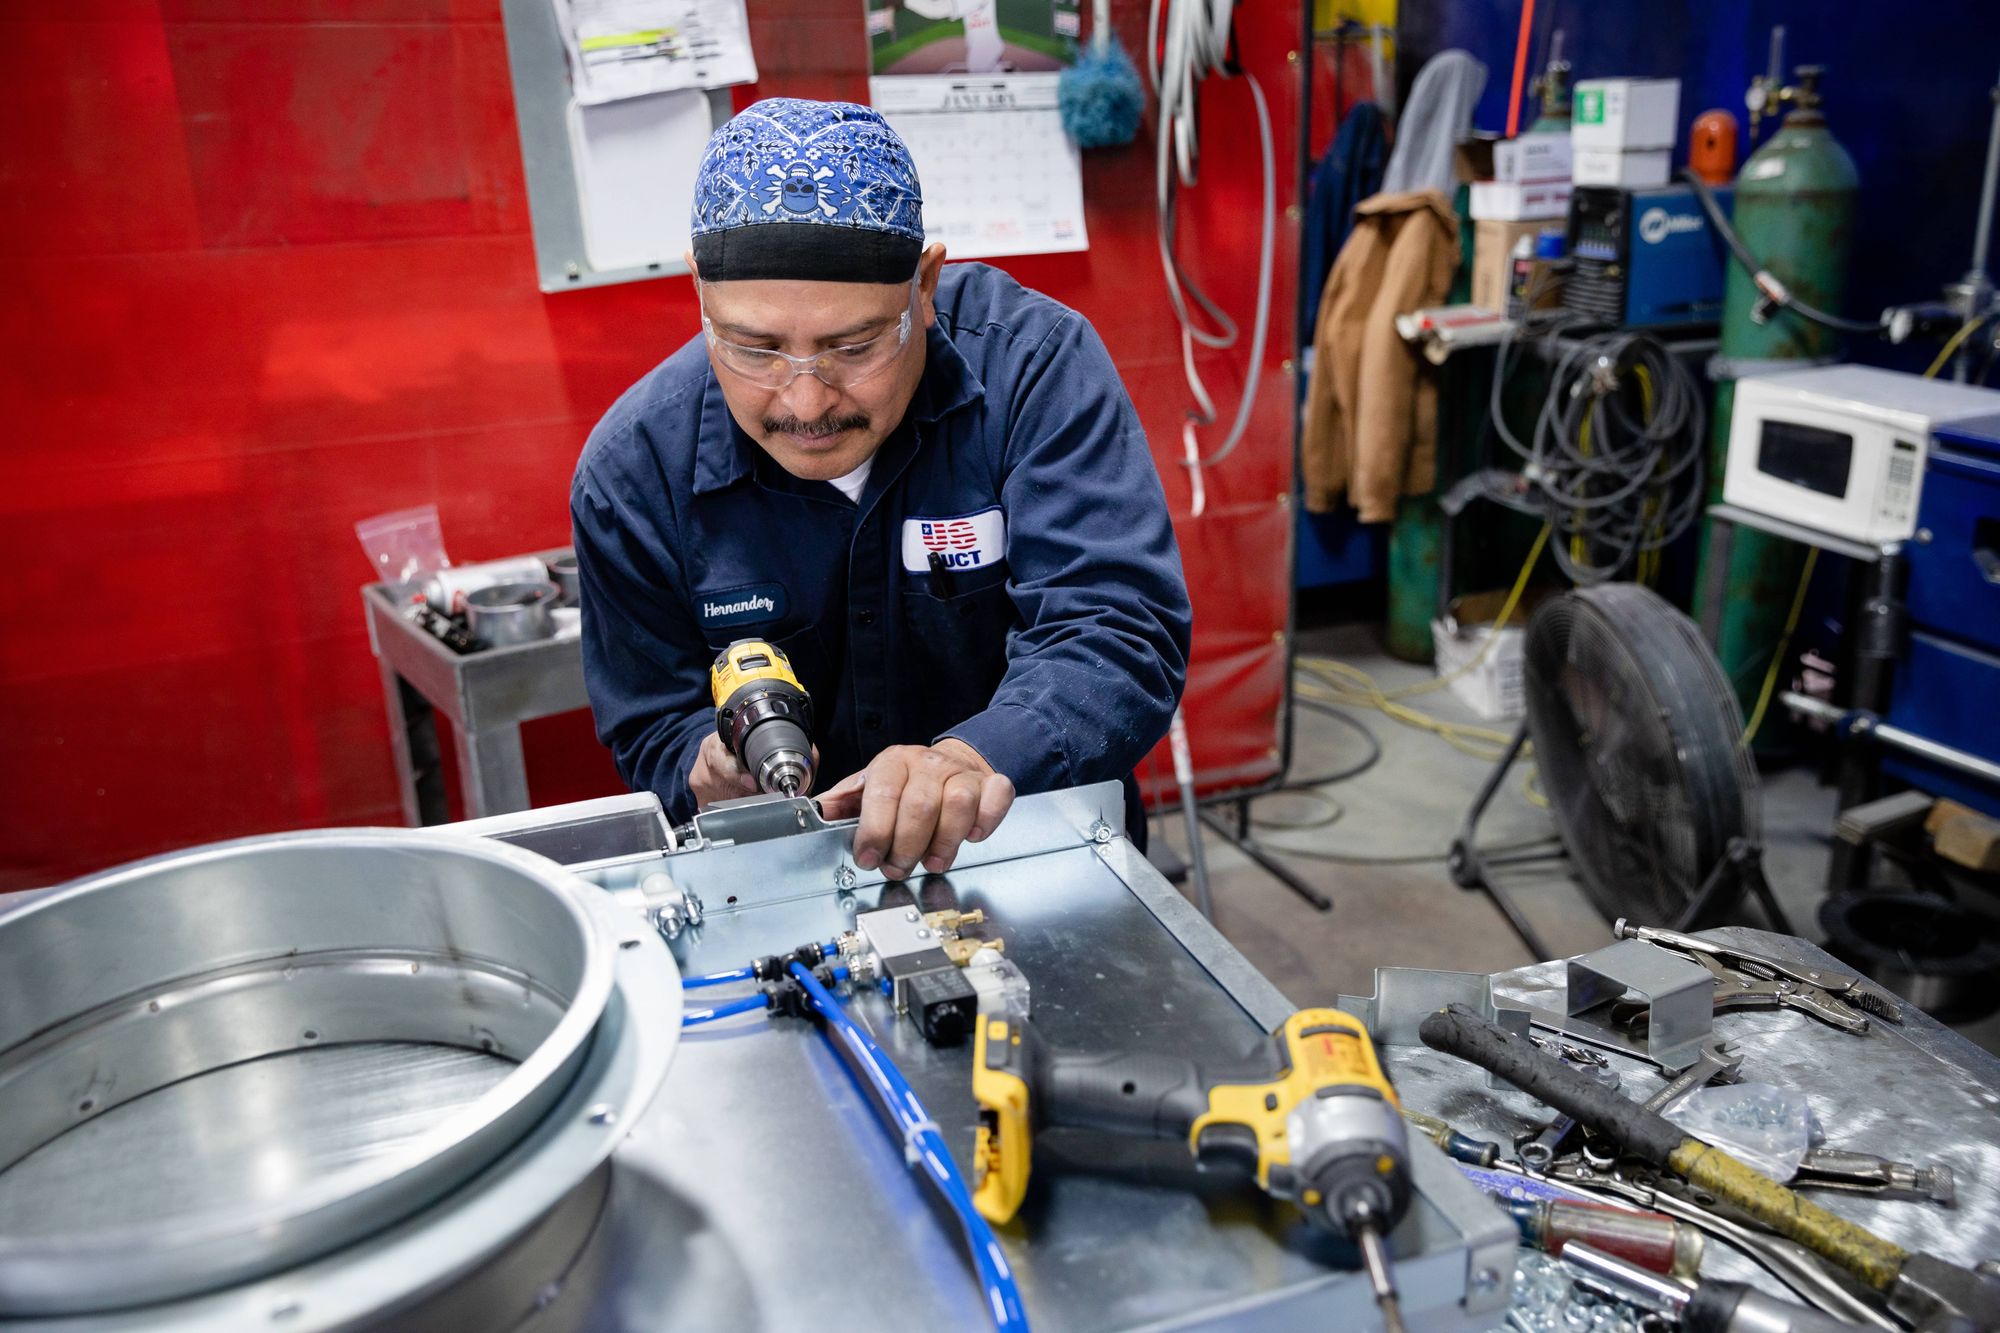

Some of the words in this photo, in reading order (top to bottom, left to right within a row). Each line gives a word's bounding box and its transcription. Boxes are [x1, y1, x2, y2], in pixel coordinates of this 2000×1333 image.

[921, 521, 977, 551] US
[927, 550, 982, 568] UCT
[704, 595, 774, 618] Hernandez
